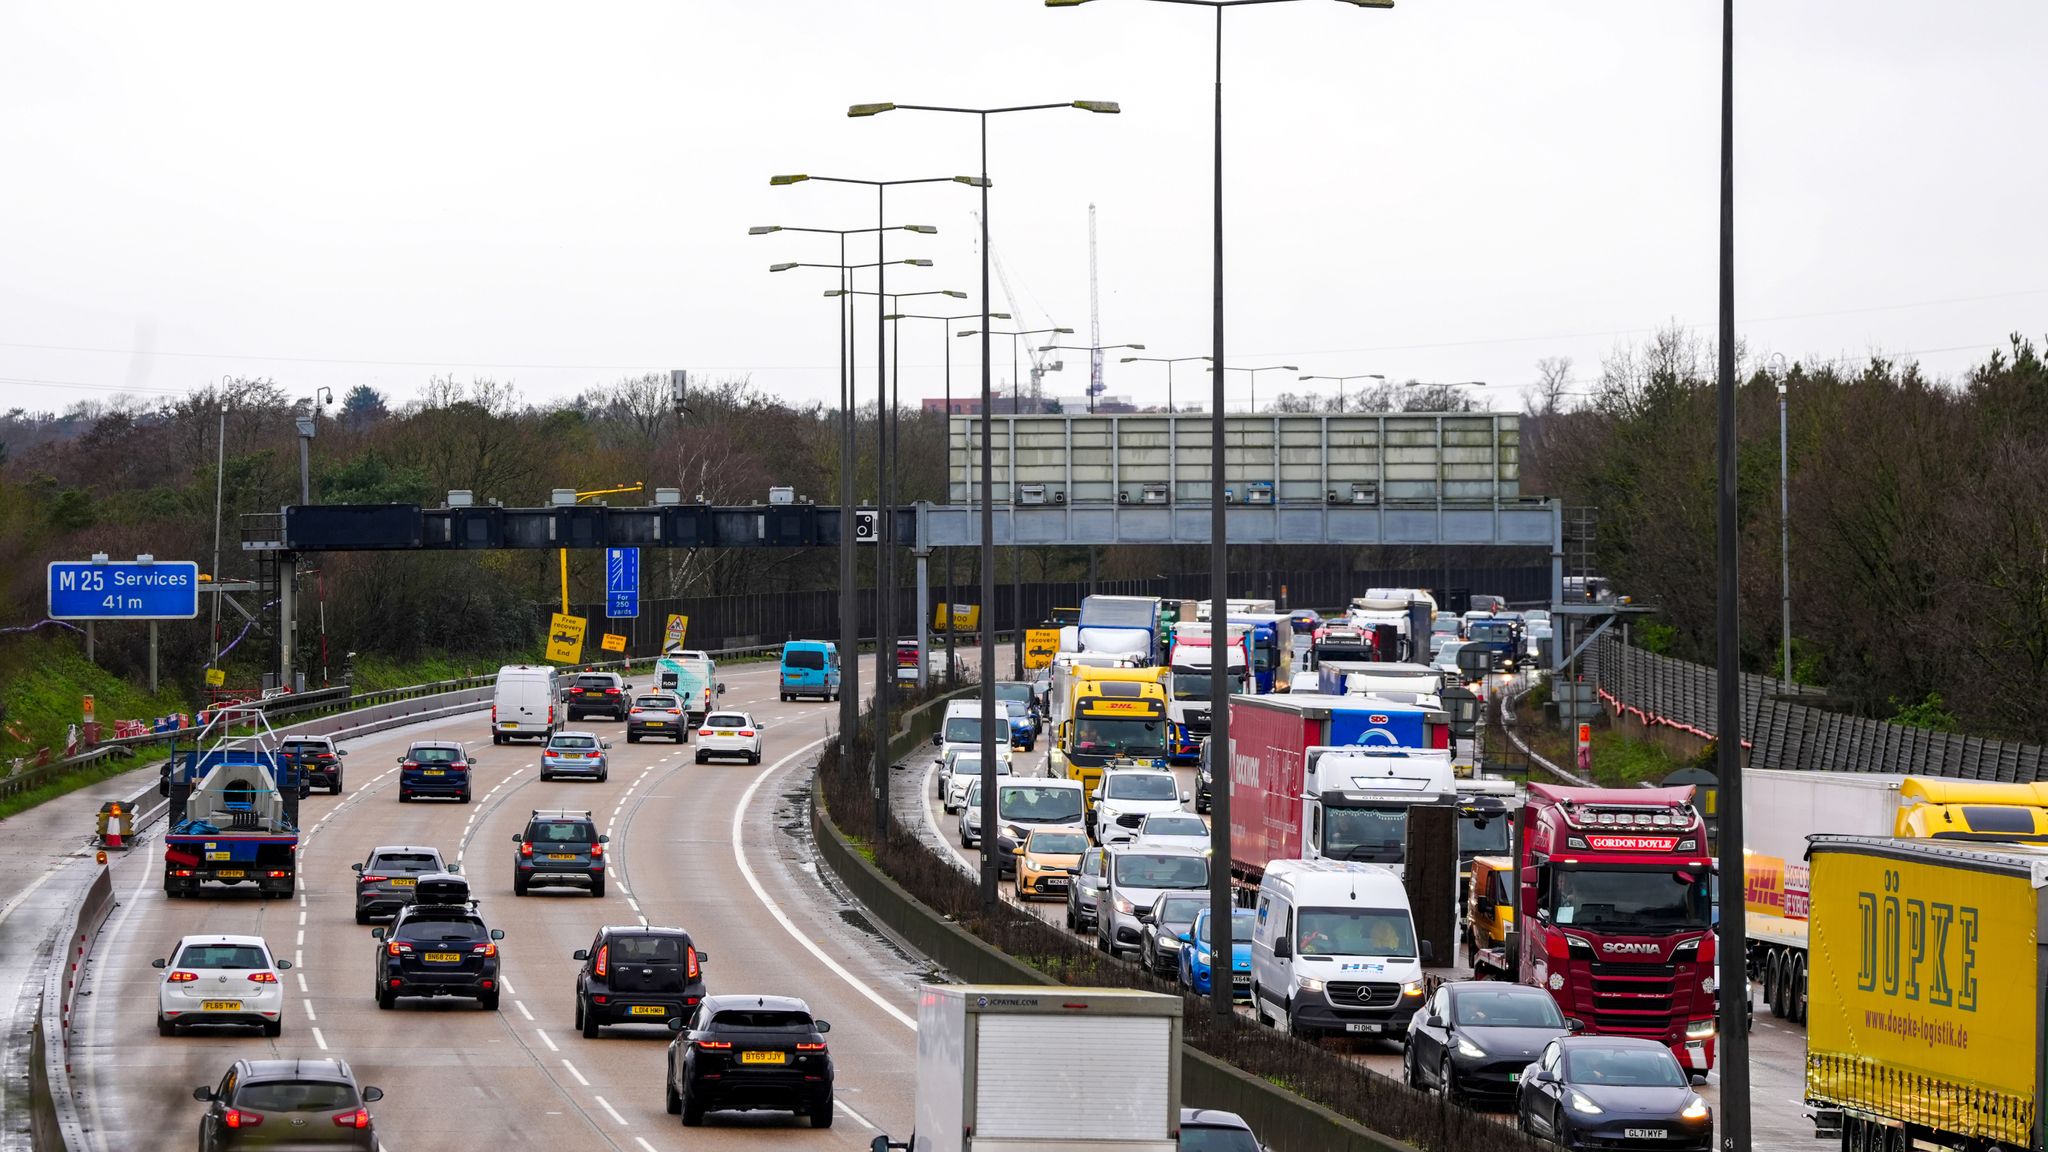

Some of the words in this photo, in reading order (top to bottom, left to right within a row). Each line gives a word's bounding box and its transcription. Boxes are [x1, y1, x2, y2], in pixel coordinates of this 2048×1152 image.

[60, 571, 75, 591] M
[81, 571, 104, 591] 25
[114, 571, 187, 586] Services
[561, 616, 577, 625] Free
[553, 621, 582, 632] recovery
[556, 648, 570, 657] End
[1370, 715, 1388, 724] SDC
[1593, 838, 1637, 848] GORDON
[1638, 839, 1672, 849] DOYLE
[1858, 869, 1978, 1012] DÖPKE
[1602, 942, 1661, 954] SCANIA
[989, 998, 1038, 1006] JCPAYNE.COM
[1865, 1009, 1968, 1049] www.doepke-logistik.de
[745, 1053, 766, 1061] BT69
[1628, 1129, 1648, 1138] GL71
